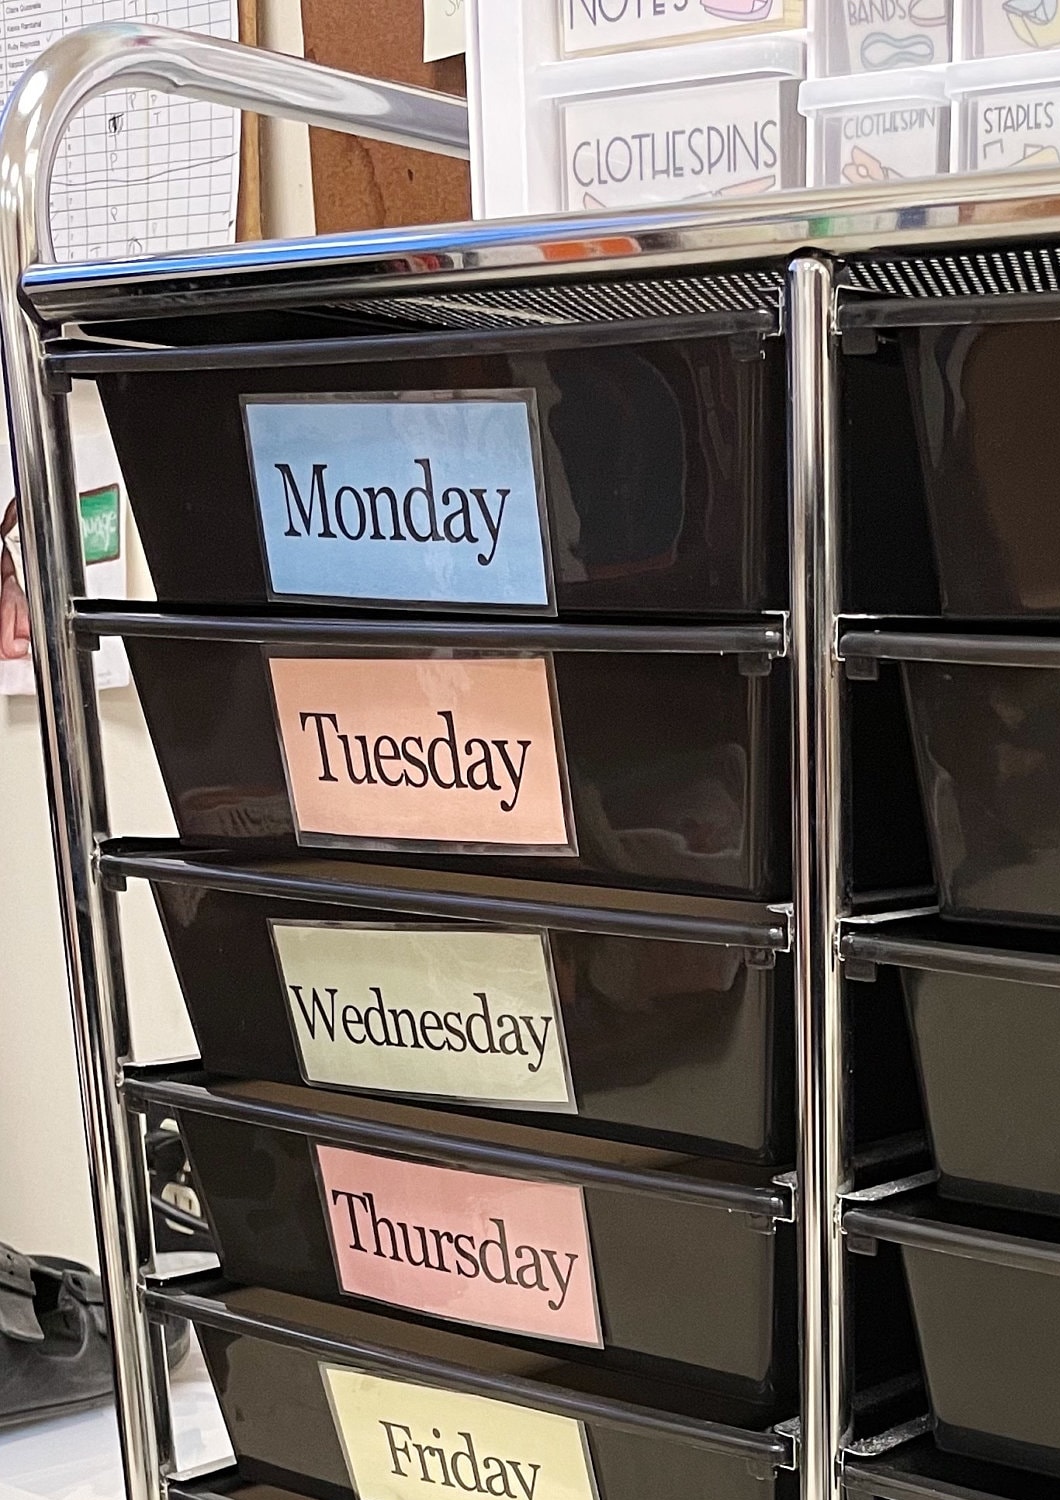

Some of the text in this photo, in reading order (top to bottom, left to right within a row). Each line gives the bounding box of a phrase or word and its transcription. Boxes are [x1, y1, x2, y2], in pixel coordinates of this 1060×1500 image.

[848, 0, 907, 26] BANDS
[572, 119, 778, 188] CLOTHESPINS
[843, 107, 936, 140] CLOTHESPIN
[983, 101, 1055, 134] STAPLES
[274, 458, 511, 566] Monday
[299, 710, 532, 812] Tuesday
[287, 984, 553, 1073] Wednesday
[331, 1189, 579, 1312] Thursday
